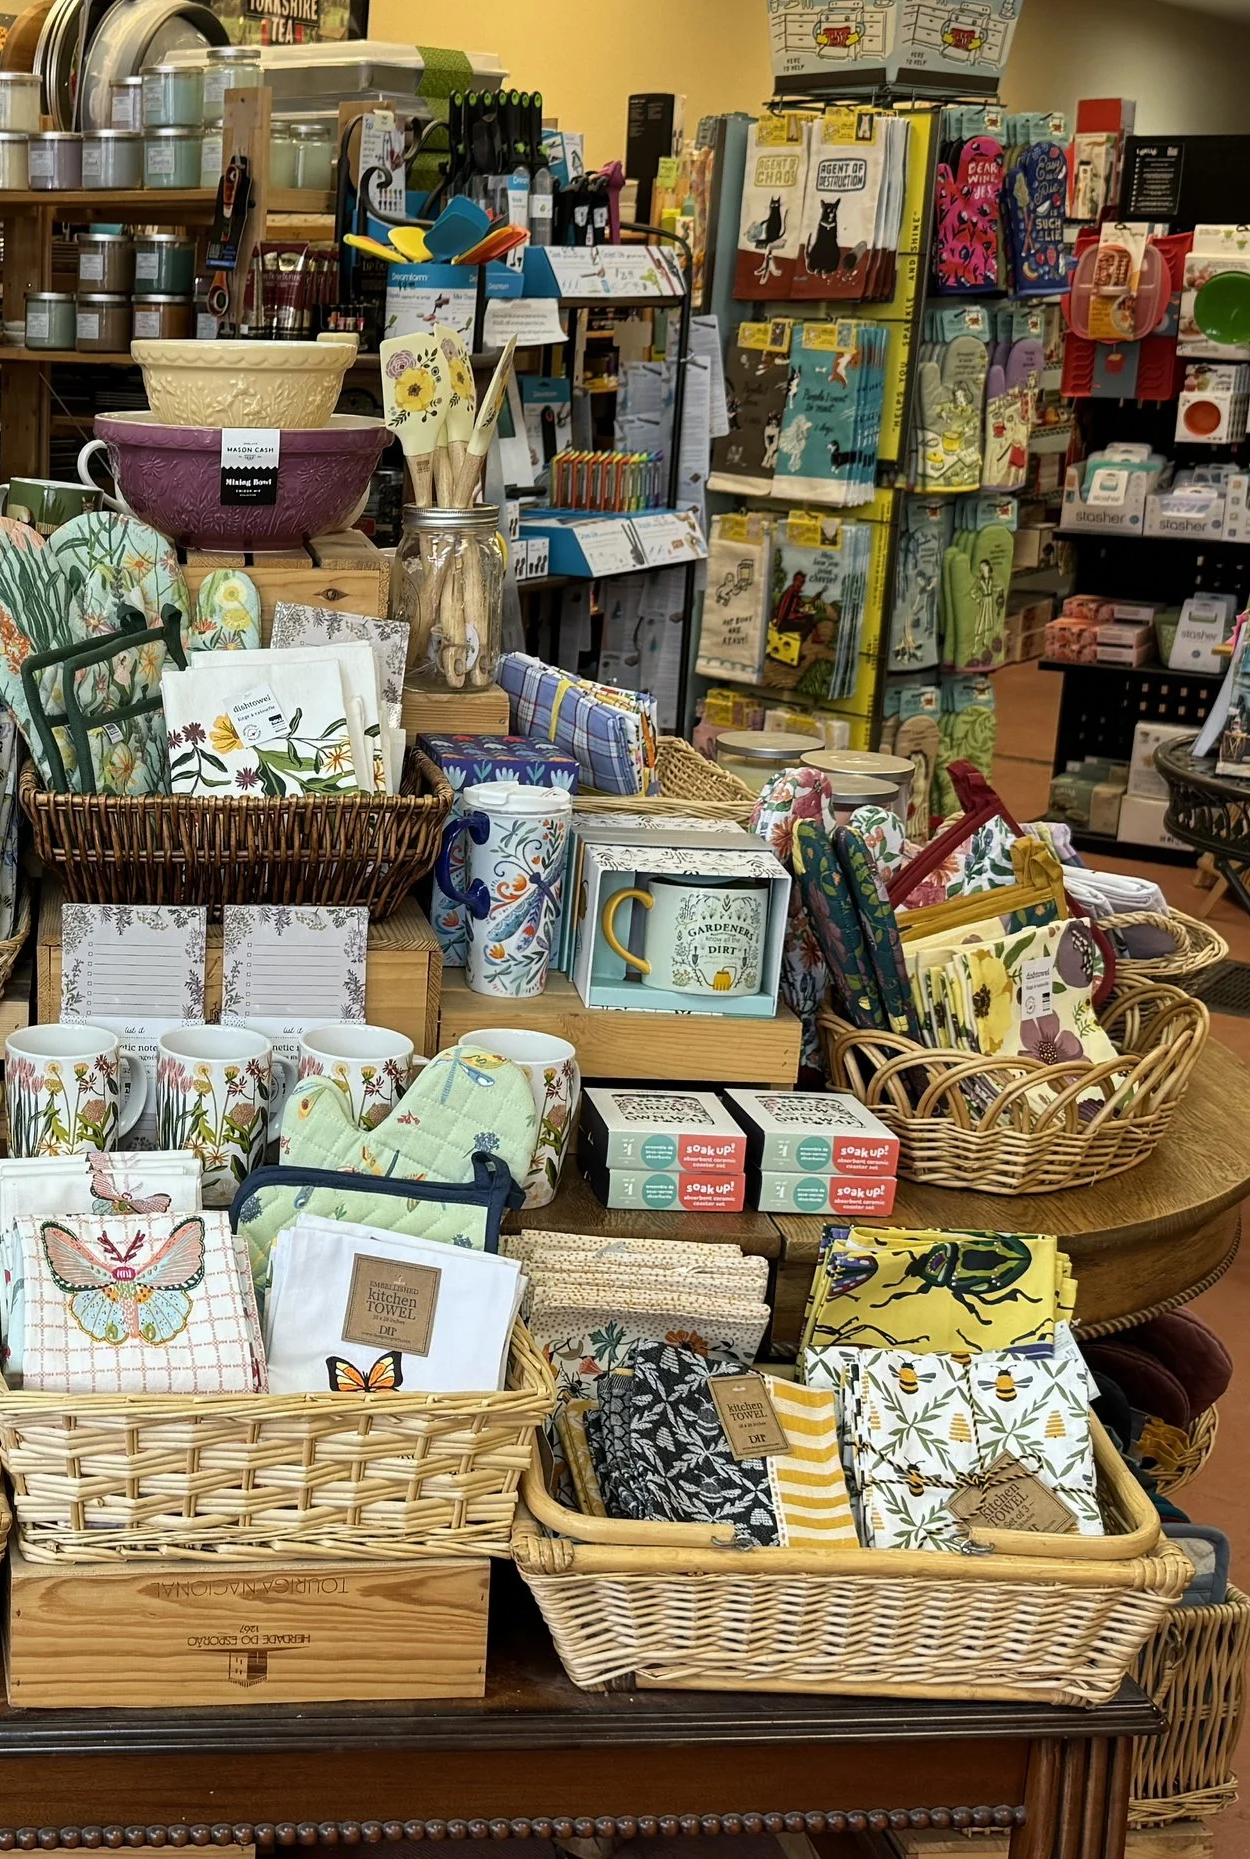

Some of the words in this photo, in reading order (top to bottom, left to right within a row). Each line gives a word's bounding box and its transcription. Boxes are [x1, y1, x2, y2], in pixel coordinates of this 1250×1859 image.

[271, 18, 293, 43] TEA
[759, 157, 783, 170] AGENT
[820, 164, 848, 175] AGENT
[852, 163, 864, 174] OF
[968, 161, 998, 175] DEAR
[758, 170, 796, 184] CHAOS
[819, 175, 863, 188] DESTRUCTION
[1036, 218, 1061, 230] SUCH
[1045, 230, 1062, 241] LIE
[908, 259, 916, 281] AND
[903, 296, 914, 347] SPARKLE
[899, 362, 909, 383] YOU
[225, 479, 251, 487] Mixing
[253, 478, 272, 486] Bowl
[1076, 510, 1126, 525] stasher
[1159, 519, 1207, 532] stasher
[1181, 629, 1218, 642] stasher
[233, 694, 271, 713] dishtowel
[688, 923, 754, 941] GARDENERS
[708, 945, 737, 955] DIRT
[138, 1043, 157, 1051] note
[272, 1043, 294, 1051] netic
[686, 1144, 715, 1156] soak
[716, 1143, 735, 1156] up!
[840, 1146, 869, 1158] soak
[870, 1145, 889, 1158] up!
[686, 1183, 715, 1194] soak
[717, 1181, 735, 1194] up!
[837, 1186, 865, 1197] soak
[866, 1184, 885, 1198] up!
[370, 1280, 419, 1295] EMBELLISHED
[368, 1287, 417, 1308] kitchen
[366, 1300, 416, 1320] TOWEL
[727, 1402, 763, 1413] kitchen
[730, 1410, 768, 1421] TOWEL
[980, 1482, 1020, 1519] kitchen
[987, 1491, 1029, 1527] TOWEL
[1003, 1516, 1016, 1529] Set
[1015, 1510, 1026, 1520] of
[1021, 1505, 1030, 1513] 3
[157, 1580, 256, 1598] NACIONAL
[262, 1577, 349, 1594] TOURIGA
[239, 1624, 260, 1633] 1267
[187, 1636, 238, 1648] ESPORÃO
[241, 1635, 259, 1645] DO
[262, 1634, 311, 1644] HERDADE
